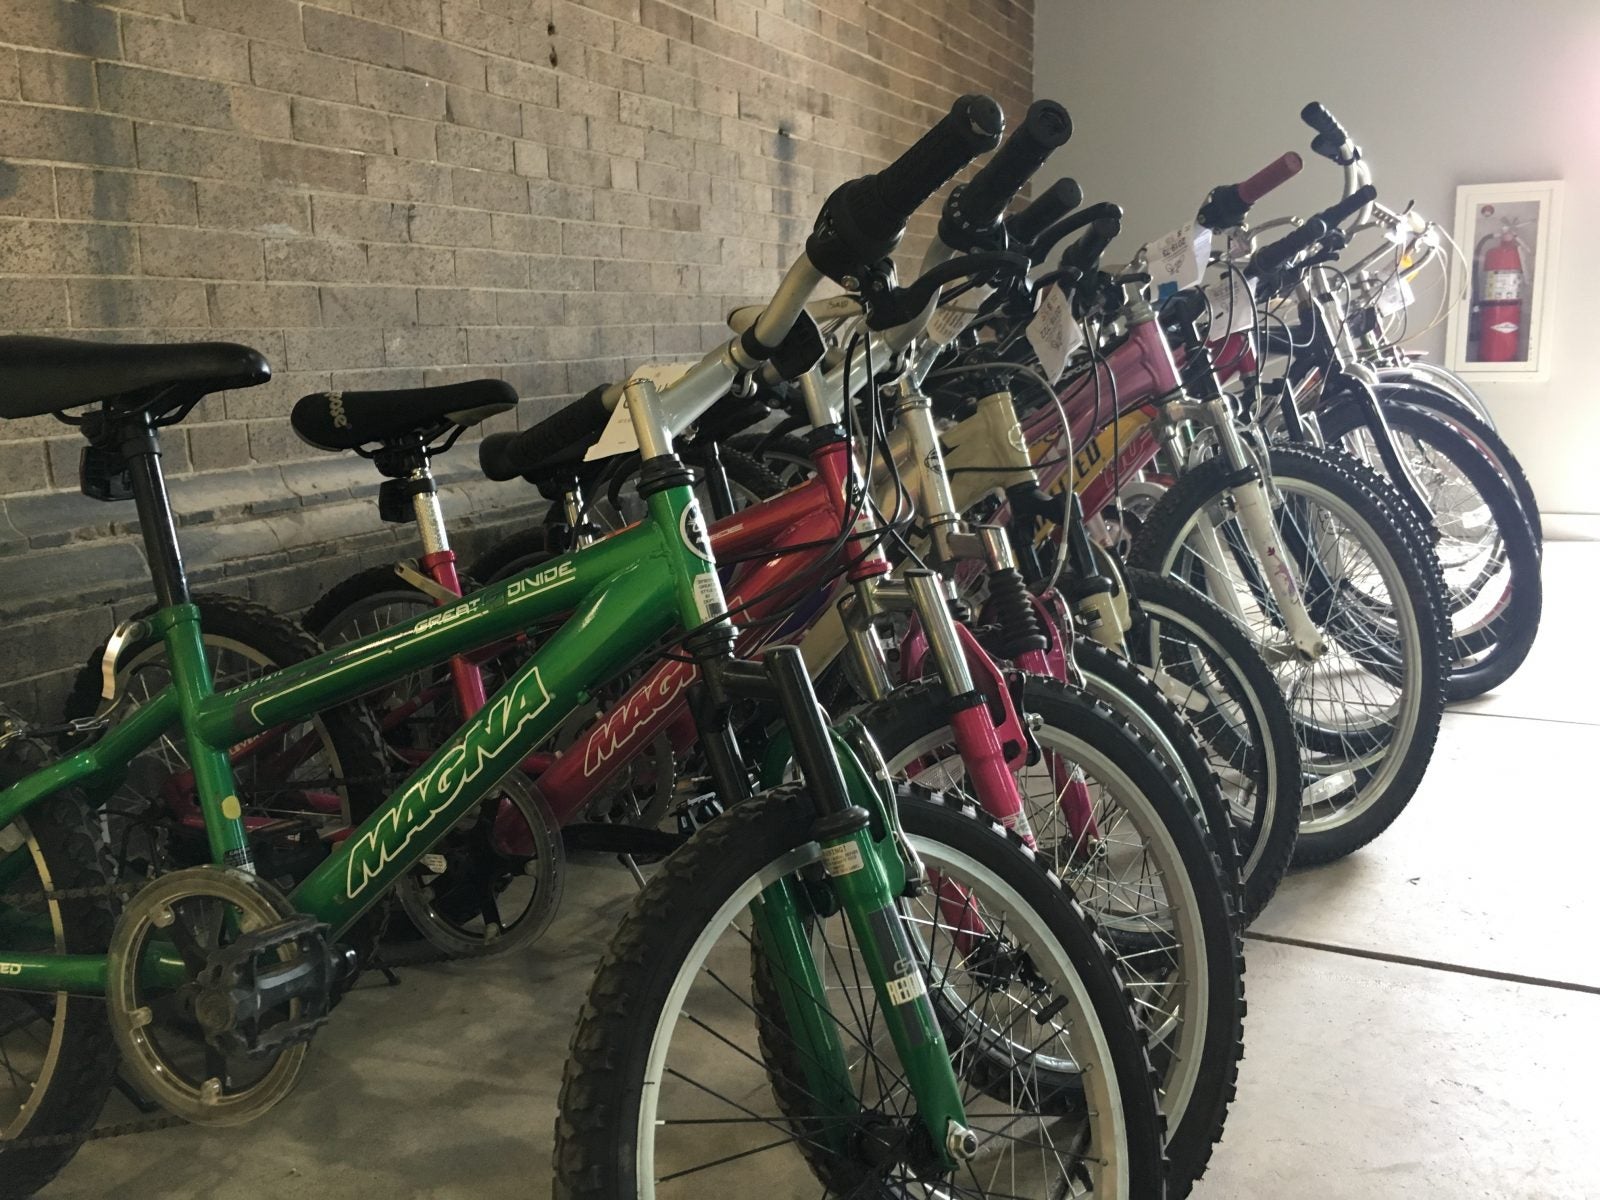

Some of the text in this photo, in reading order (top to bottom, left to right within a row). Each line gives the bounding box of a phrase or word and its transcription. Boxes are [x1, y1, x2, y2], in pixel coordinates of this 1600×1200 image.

[414, 560, 576, 634] GREAT DIVIDE
[584, 648, 698, 778] MAG
[346, 666, 551, 899] MAGNA
